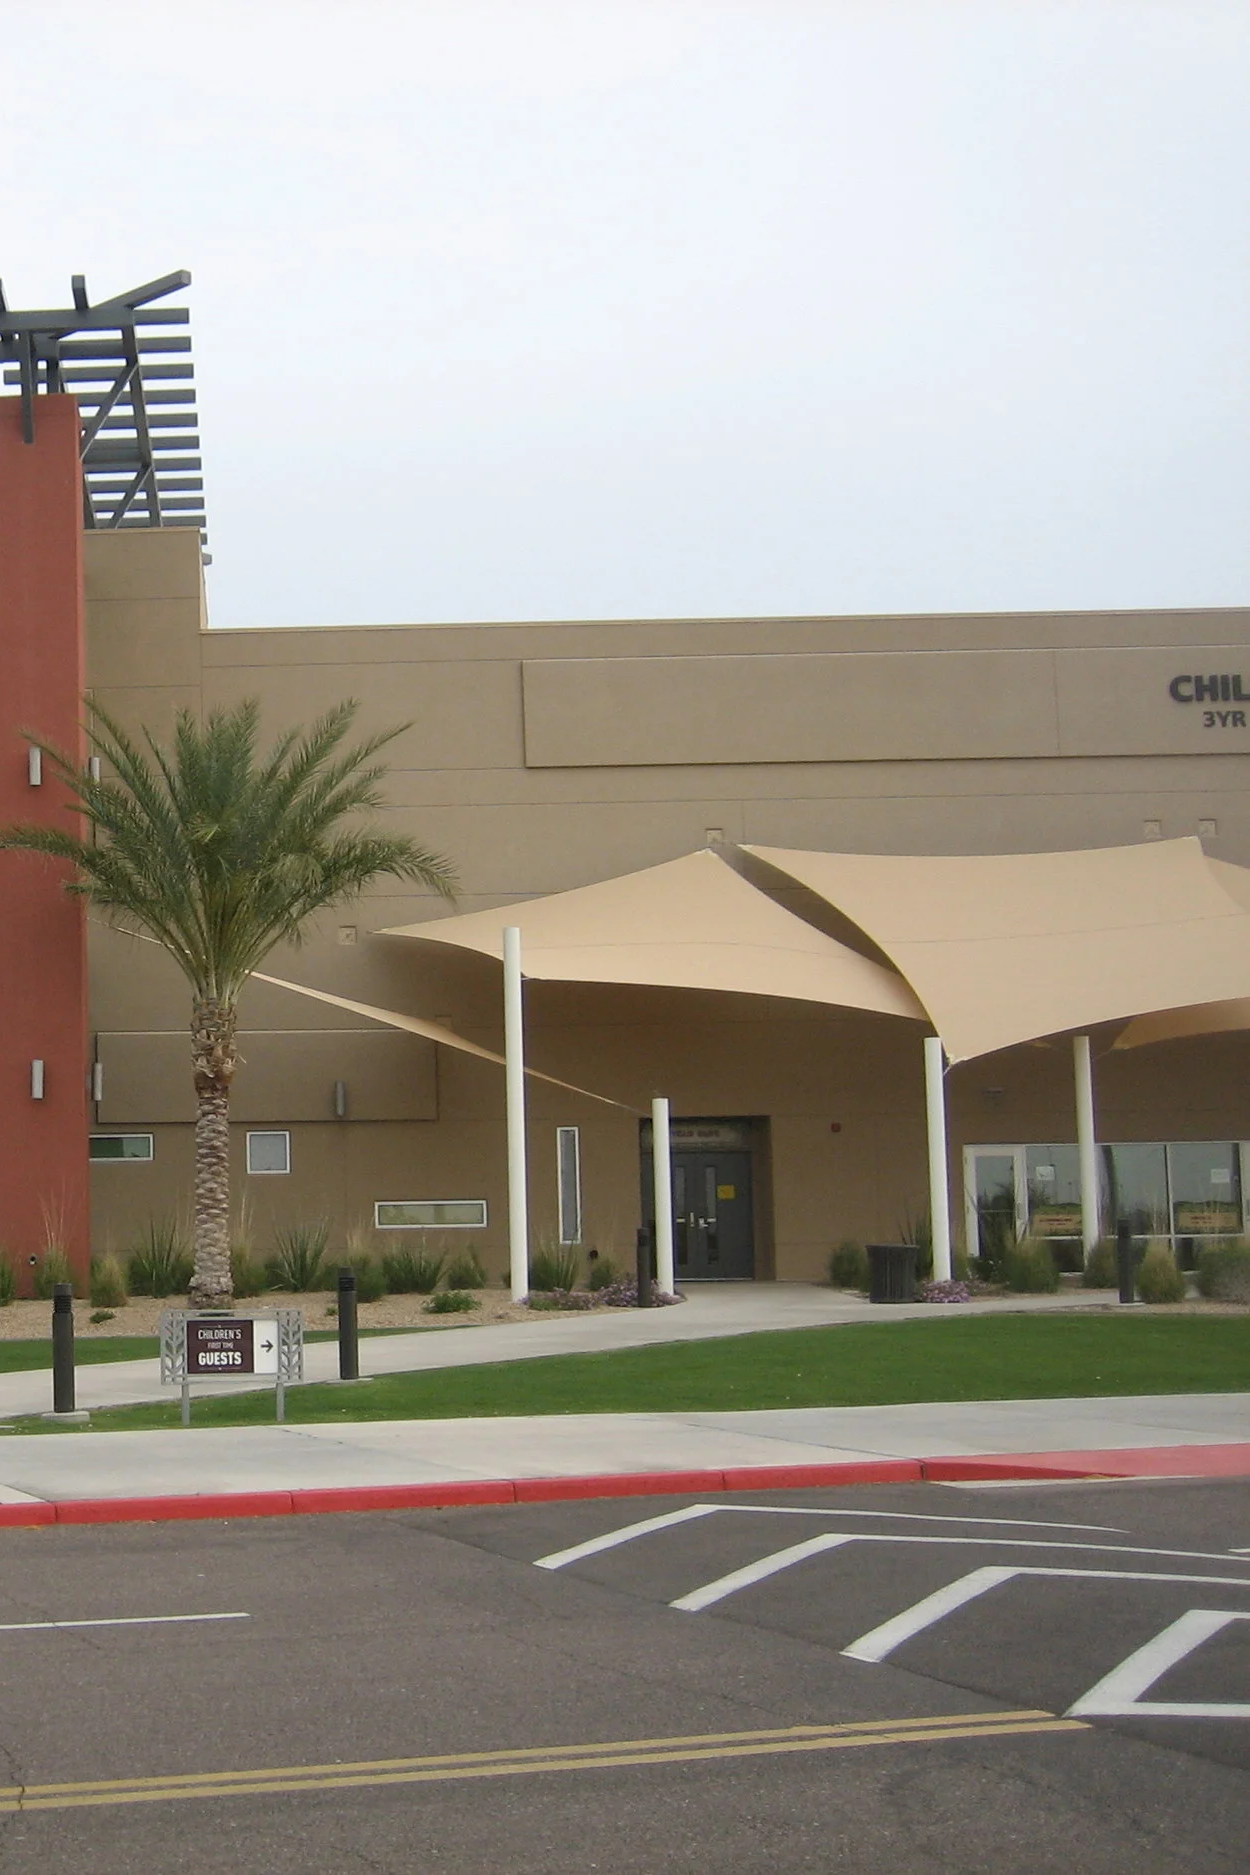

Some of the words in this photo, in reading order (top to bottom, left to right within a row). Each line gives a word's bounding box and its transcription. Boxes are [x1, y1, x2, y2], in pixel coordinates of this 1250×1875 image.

[1202, 710, 1247, 728] 3YR
[197, 1329, 242, 1340] CHILDREN'S
[198, 1351, 242, 1366] GUESTS
